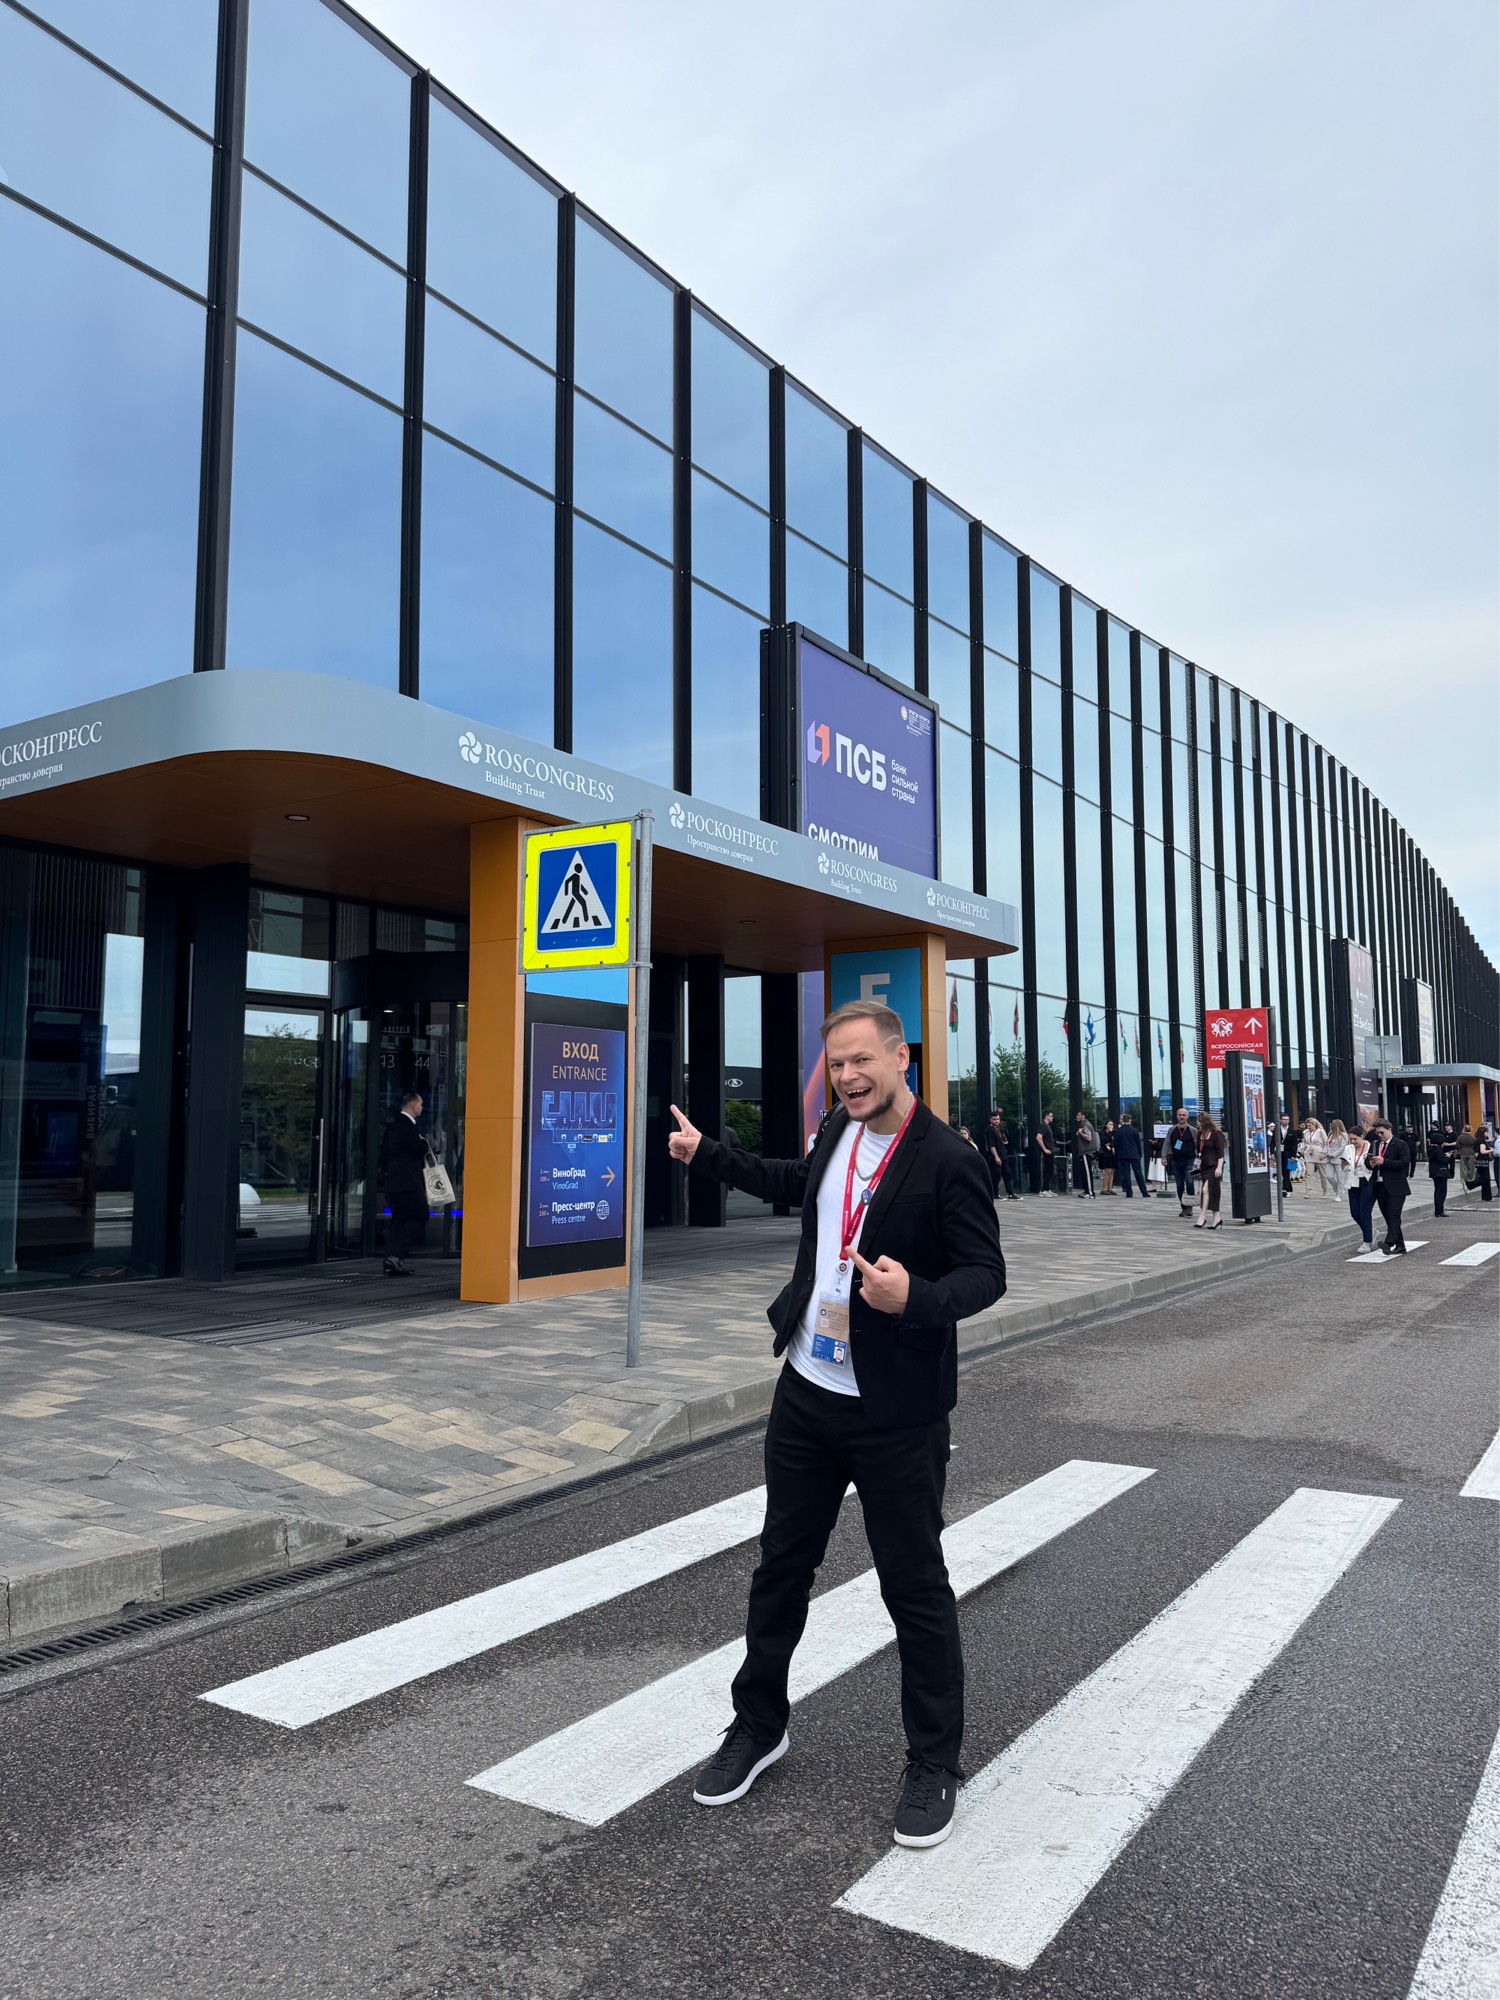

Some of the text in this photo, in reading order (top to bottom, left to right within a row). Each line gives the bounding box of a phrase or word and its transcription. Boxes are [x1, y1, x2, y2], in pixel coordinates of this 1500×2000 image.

[32, 763, 64, 779] доверия
[835, 732, 887, 792] ПСБ
[891, 759, 908, 776] банк
[484, 743, 615, 803] ROSCONGRESS
[485, 770, 546, 799] Building Trust
[891, 774, 919, 793] сильной
[891, 787, 916, 805] страны
[686, 811, 779, 856] РОСКОНГРЕСС
[687, 834, 730, 855] Пространство
[830, 859, 898, 893] ROSCONGRESS
[936, 893, 990, 920] РОСКОНГРЕСС
[562, 1041, 599, 1062] ВХОД
[1211, 1042, 1264, 1050] ВСЕРОССИЙСКАЯ
[552, 1065, 607, 1081] ENTRANCE
[552, 1167, 586, 1179] ВиноГрад
[552, 1180, 579, 1190] VinoGrad
[551, 1201, 596, 1214] Пресс-центр
[551, 1214, 586, 1225] Press centre
